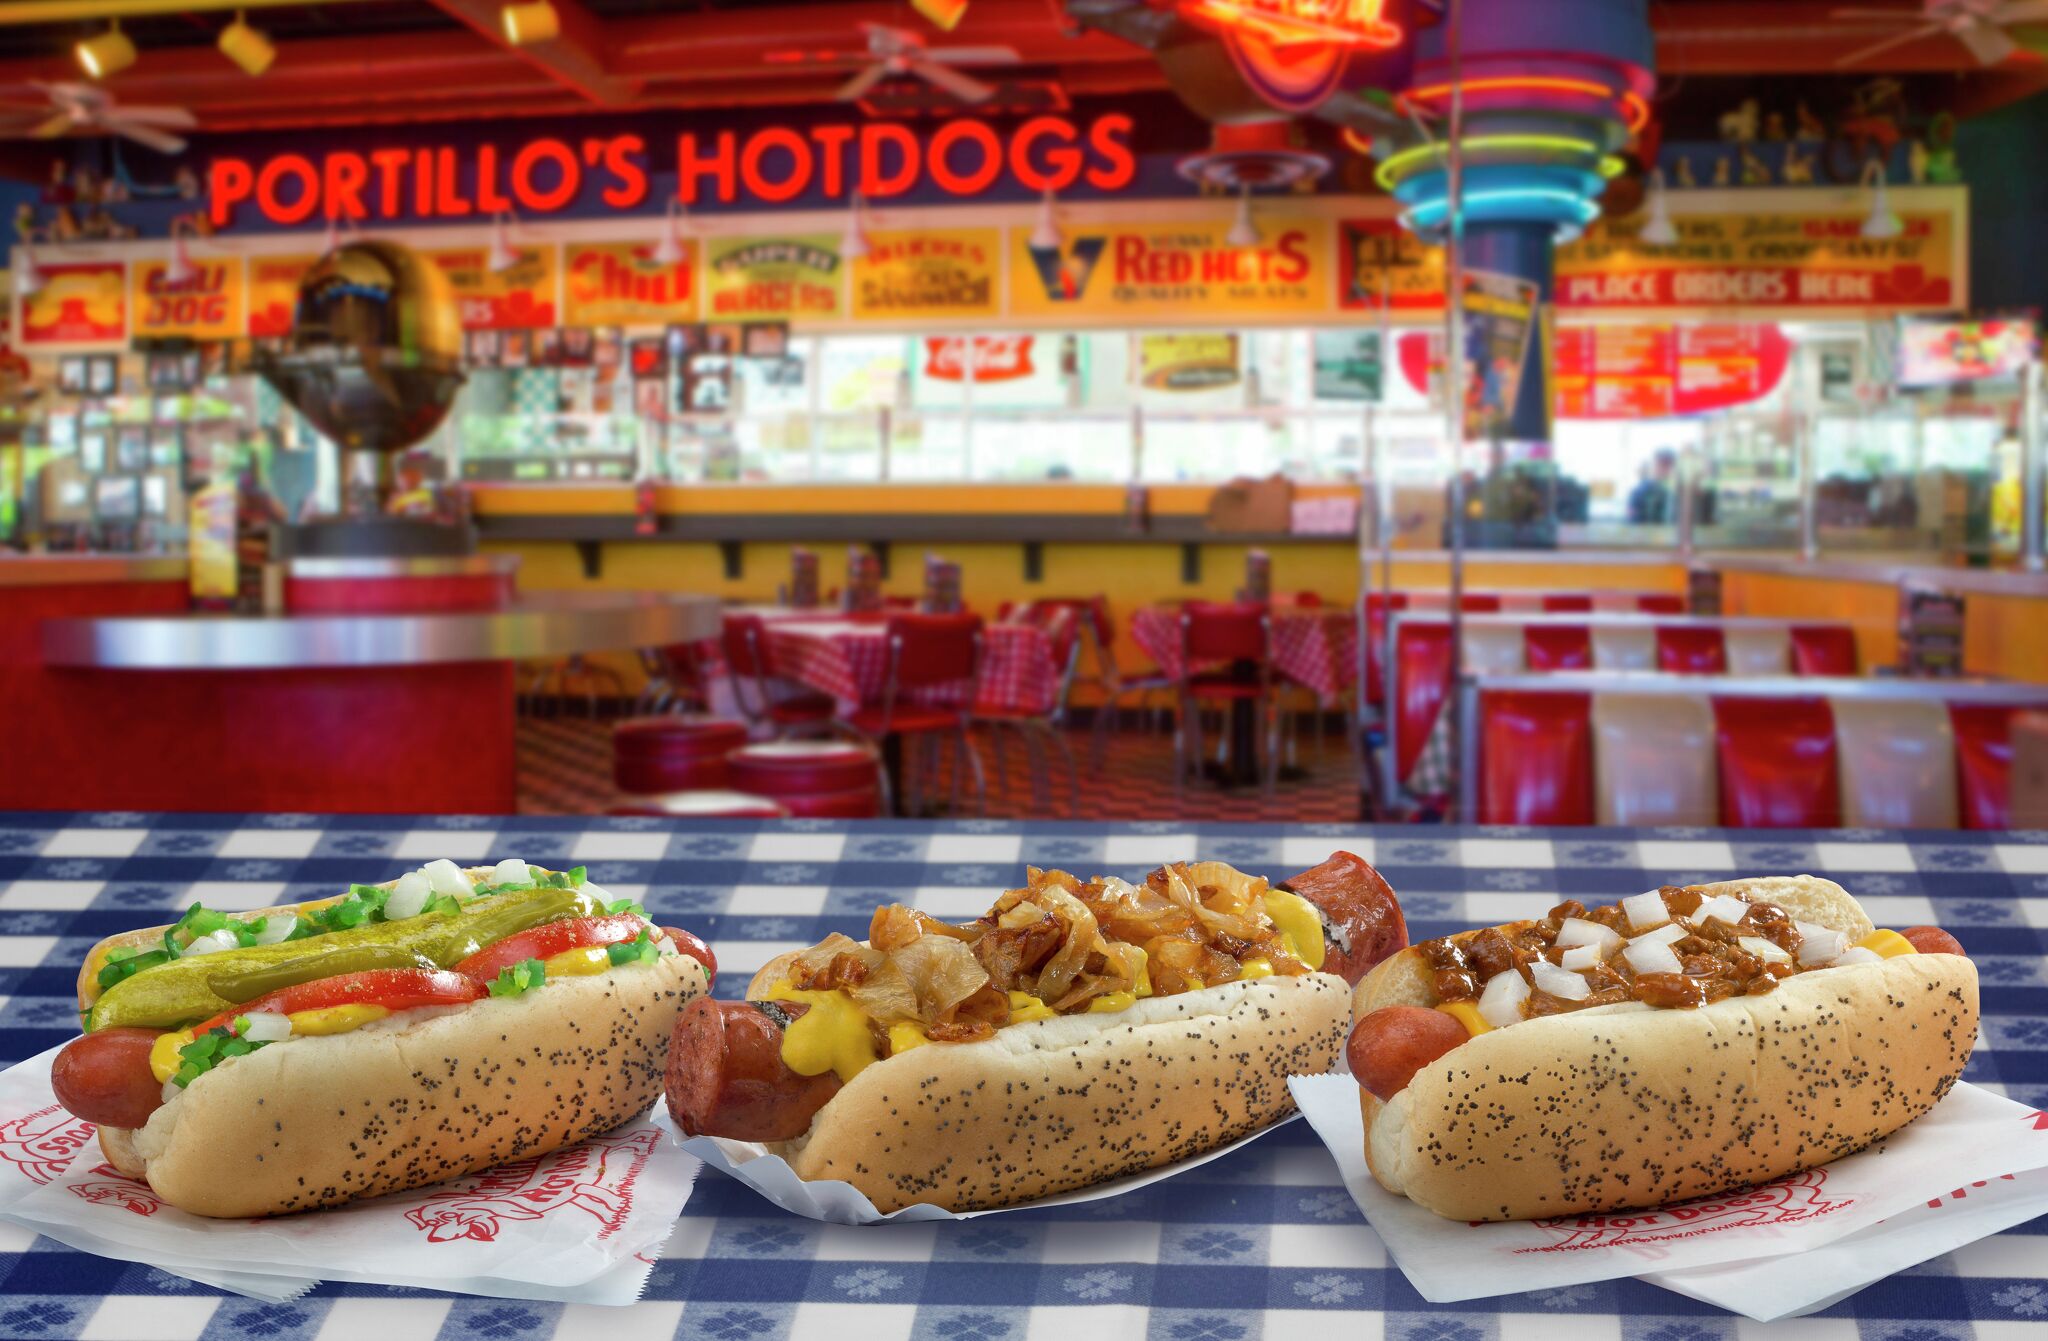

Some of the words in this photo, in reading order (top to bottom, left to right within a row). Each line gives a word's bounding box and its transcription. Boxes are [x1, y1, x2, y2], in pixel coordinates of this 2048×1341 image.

[210, 135, 647, 226] PORTILLO'S
[678, 114, 1136, 204] HOTDOGS
[1115, 234, 1195, 284] RED
[1201, 230, 1310, 283] HOTS
[1113, 286, 1209, 302] QUALITY
[1569, 272, 1657, 300] PLACE
[1672, 271, 1787, 300] ORDERS
[1802, 272, 1873, 299] HERE
[144, 295, 228, 326] DOG
[1576, 1215, 1660, 1229] HOT
[1663, 1191, 1777, 1221] DOGS
